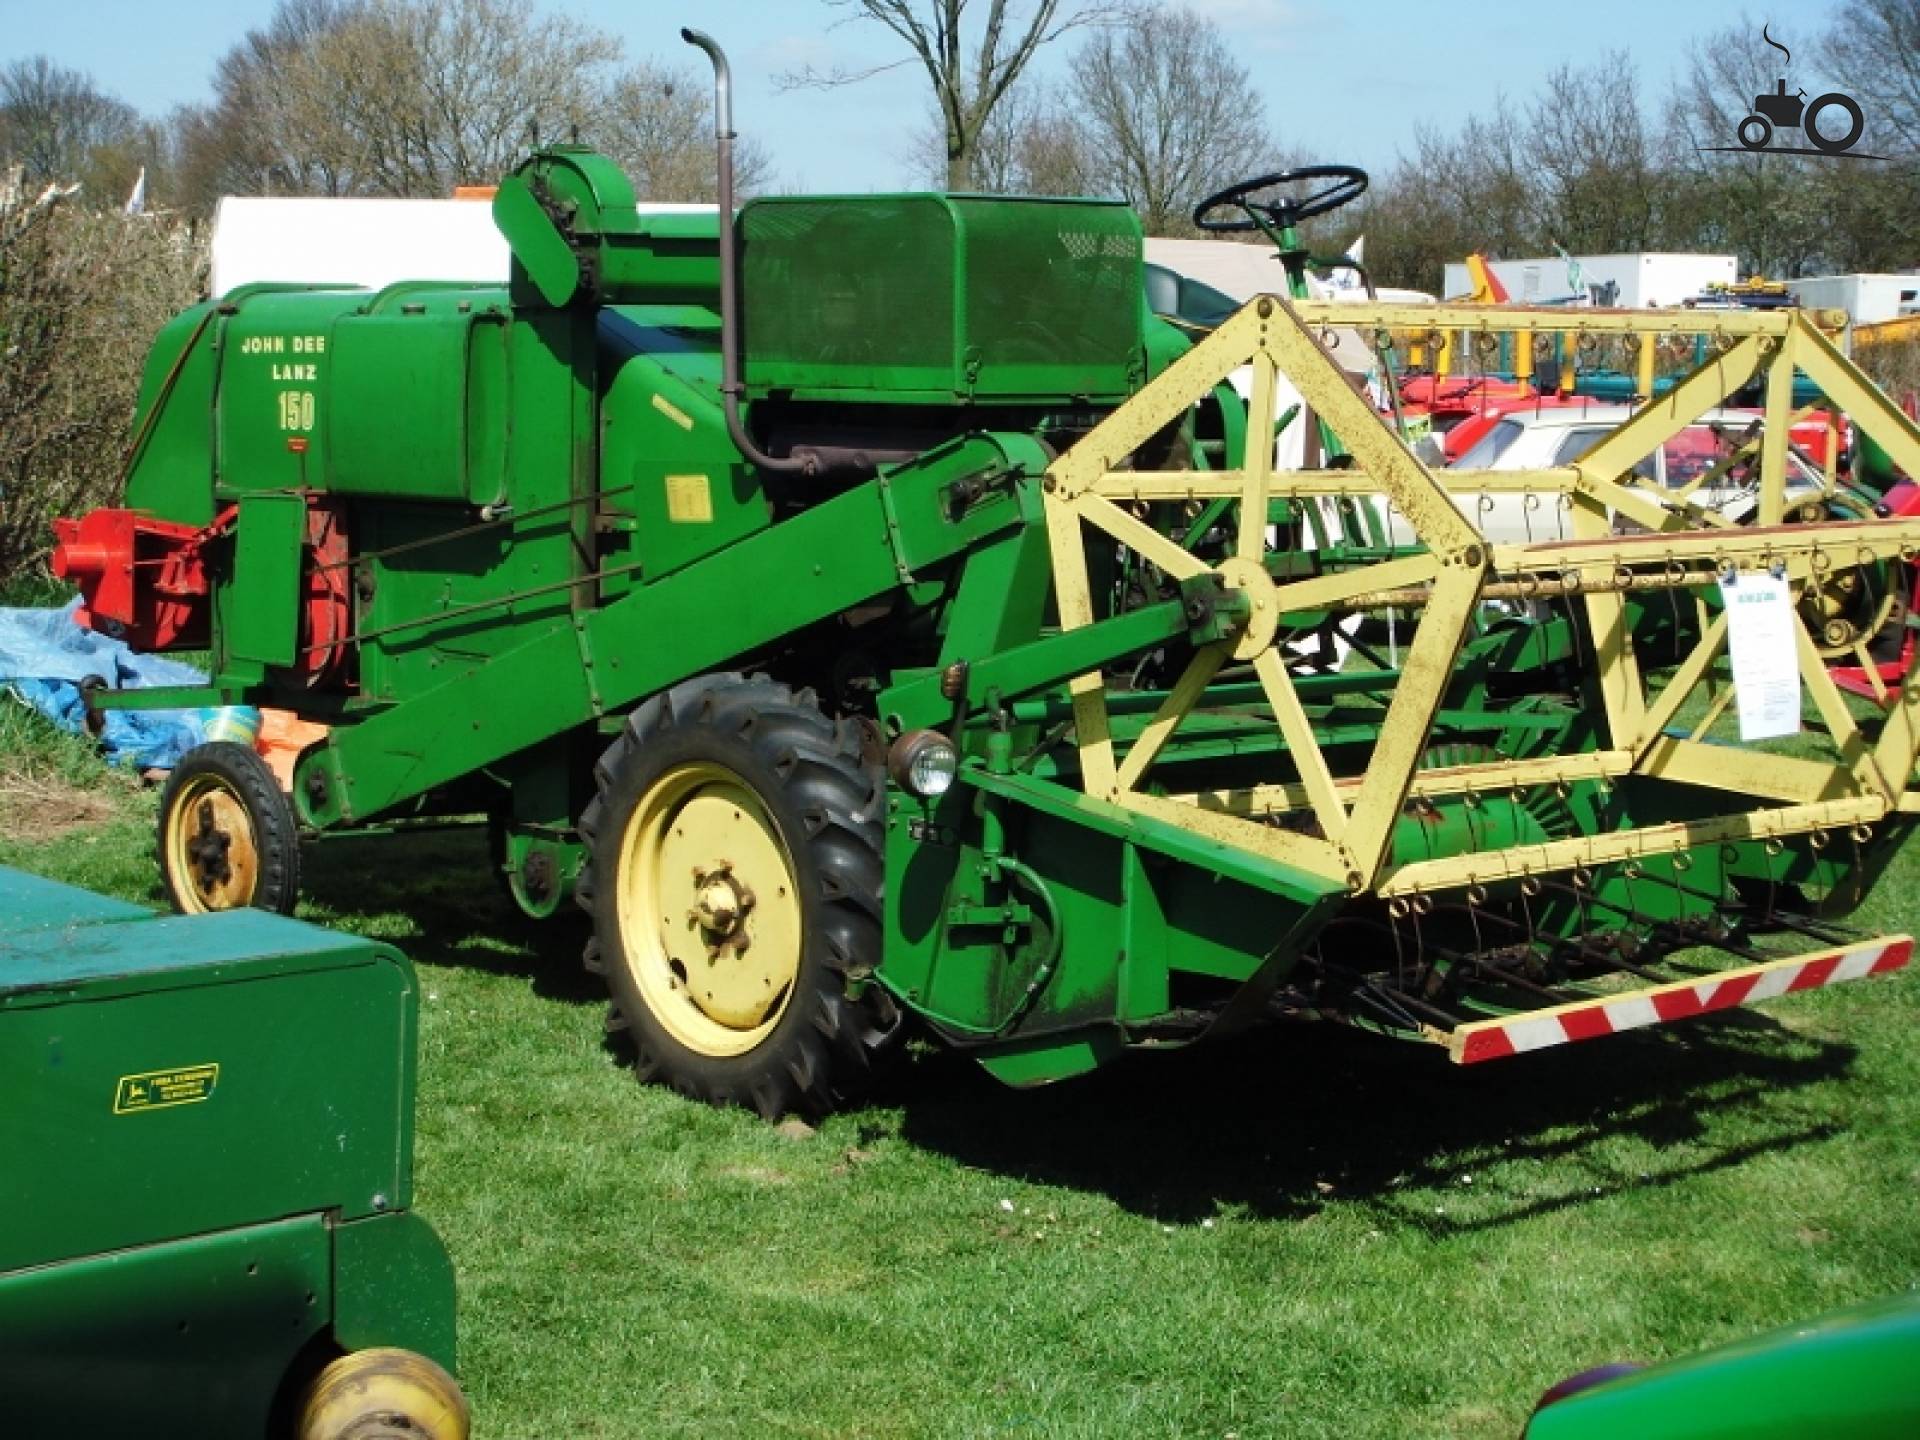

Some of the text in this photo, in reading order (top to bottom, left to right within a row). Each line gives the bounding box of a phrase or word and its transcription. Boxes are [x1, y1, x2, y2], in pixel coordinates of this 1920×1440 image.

[242, 336, 284, 354] JOHN
[272, 364, 317, 380] LANZ
[278, 390, 315, 431] 150
